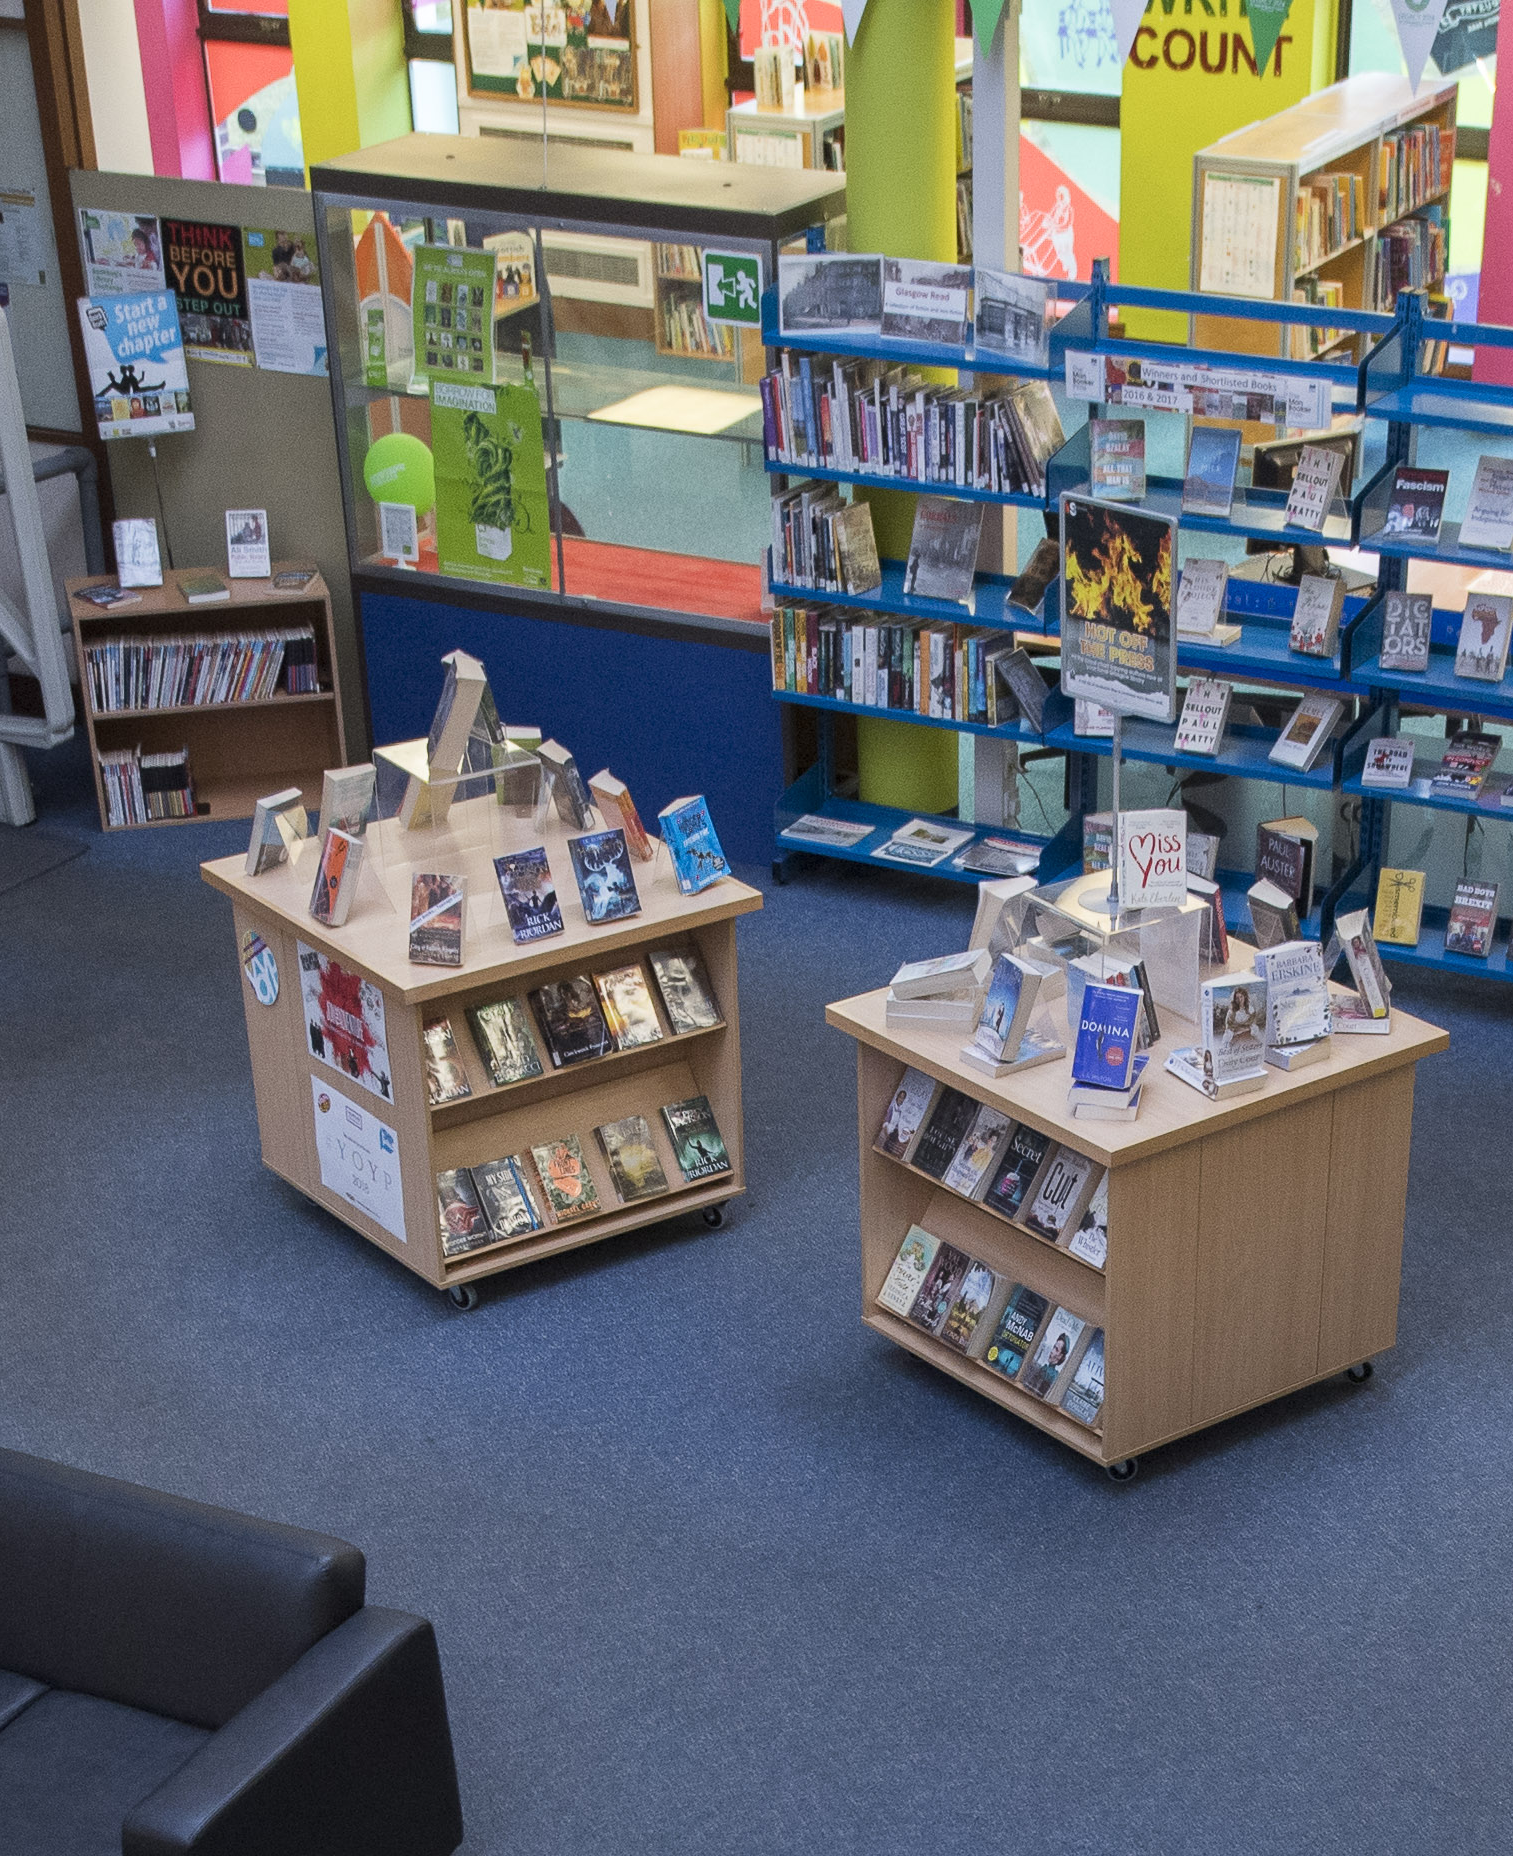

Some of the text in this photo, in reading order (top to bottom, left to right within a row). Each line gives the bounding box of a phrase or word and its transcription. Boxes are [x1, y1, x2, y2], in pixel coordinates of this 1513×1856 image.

[1129, 26, 1293, 77] COUNT
[167, 222, 233, 249] THINK
[169, 246, 236, 268] BEFORE
[171, 263, 239, 299] YOU
[895, 287, 950, 301] Glasgow Read
[113, 297, 153, 324] Start
[156, 296, 168, 311] a
[176, 298, 241, 316] STEP OUT
[127, 313, 160, 337] new
[117, 327, 177, 357] chapter
[1141, 367, 1277, 392] Winners and Shortlisted Books
[437, 395, 497, 412] IMAGINATION
[1123, 390, 1178, 405] 2016 & 2017
[1298, 471, 1328, 486] SELLOUT
[1396, 479, 1445, 493] Fascism
[1291, 488, 1323, 503] PAUL
[1287, 504, 1321, 519] BEATTY
[1084, 620, 1148, 651] HOT OFF
[1079, 637, 1106, 659] THE
[1108, 647, 1155, 672] PRESS
[1185, 703, 1222, 716] SELLOUT
[1182, 718, 1217, 730] PAUL
[1177, 732, 1215, 744] BEATTY
[1129, 832, 1181, 858] Miss
[1268, 838, 1291, 855] PAUL
[1137, 855, 1183, 889] You
[1260, 855, 1295, 878] AUSTER
[1457, 884, 1495, 897] BAD BOYS
[1454, 896, 1493, 910] BREXIT
[526, 912, 550, 926] RICK
[519, 920, 562, 940] RIORDAN
[1276, 954, 1314, 968] BARBARA
[1271, 962, 1321, 981] ERSKINE
[1081, 1019, 1130, 1039] DOMINA
[1011, 1135, 1043, 1164] Secret
[689, 1160, 728, 1180] RIORDAN
[695, 1156, 716, 1168] RICK
[1042, 1162, 1078, 1210] Cut
[1010, 1311, 1028, 1326] ANDY
[1005, 1321, 1034, 1342] McNAB
